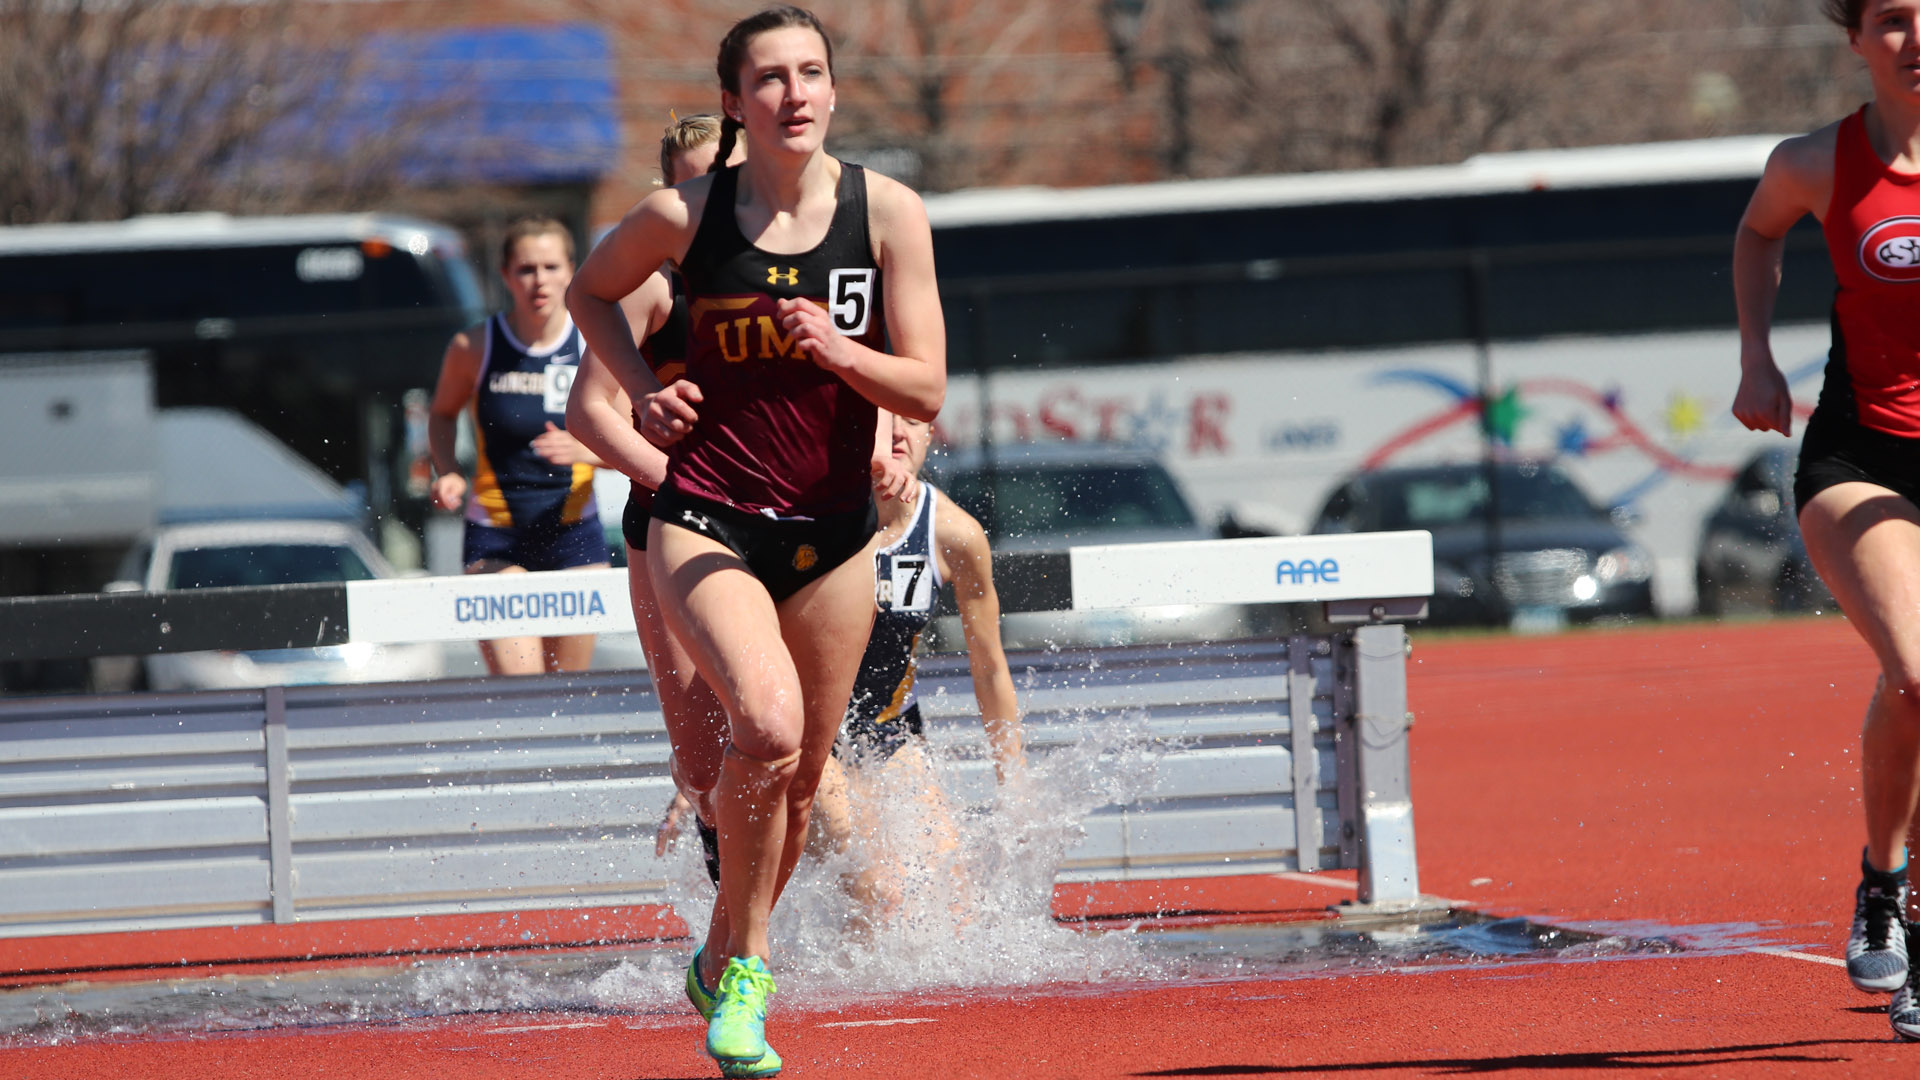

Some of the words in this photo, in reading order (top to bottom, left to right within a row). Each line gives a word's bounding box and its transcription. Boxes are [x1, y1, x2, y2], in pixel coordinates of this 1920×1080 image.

[834, 274, 867, 331] 5
[715, 315, 807, 363] UM
[555, 370, 570, 406] 9
[455, 590, 606, 622] CONCORDIA
[897, 560, 926, 607] 7
